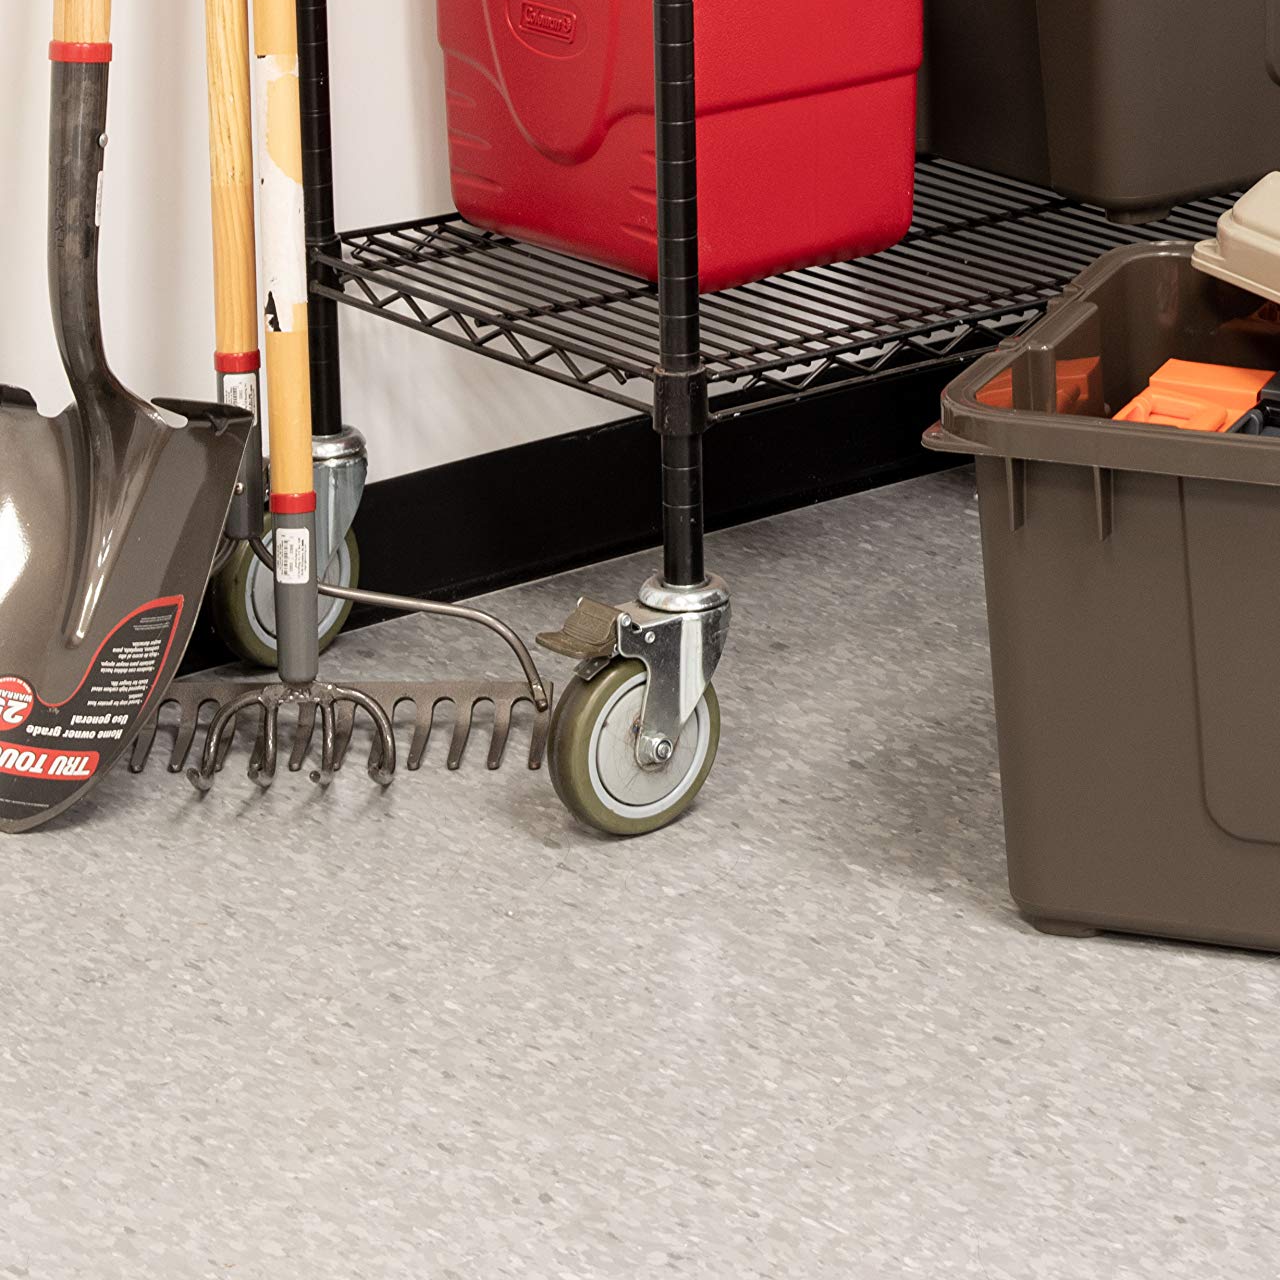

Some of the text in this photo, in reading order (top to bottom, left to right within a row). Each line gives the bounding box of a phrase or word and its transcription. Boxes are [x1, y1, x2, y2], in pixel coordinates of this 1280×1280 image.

[0, 690, 32, 702] WARRA
[0, 699, 28, 724] 2
[71, 713, 129, 726] Uso general
[26, 724, 124, 740] Home owner grade
[0, 747, 90, 776] TRU TOU
